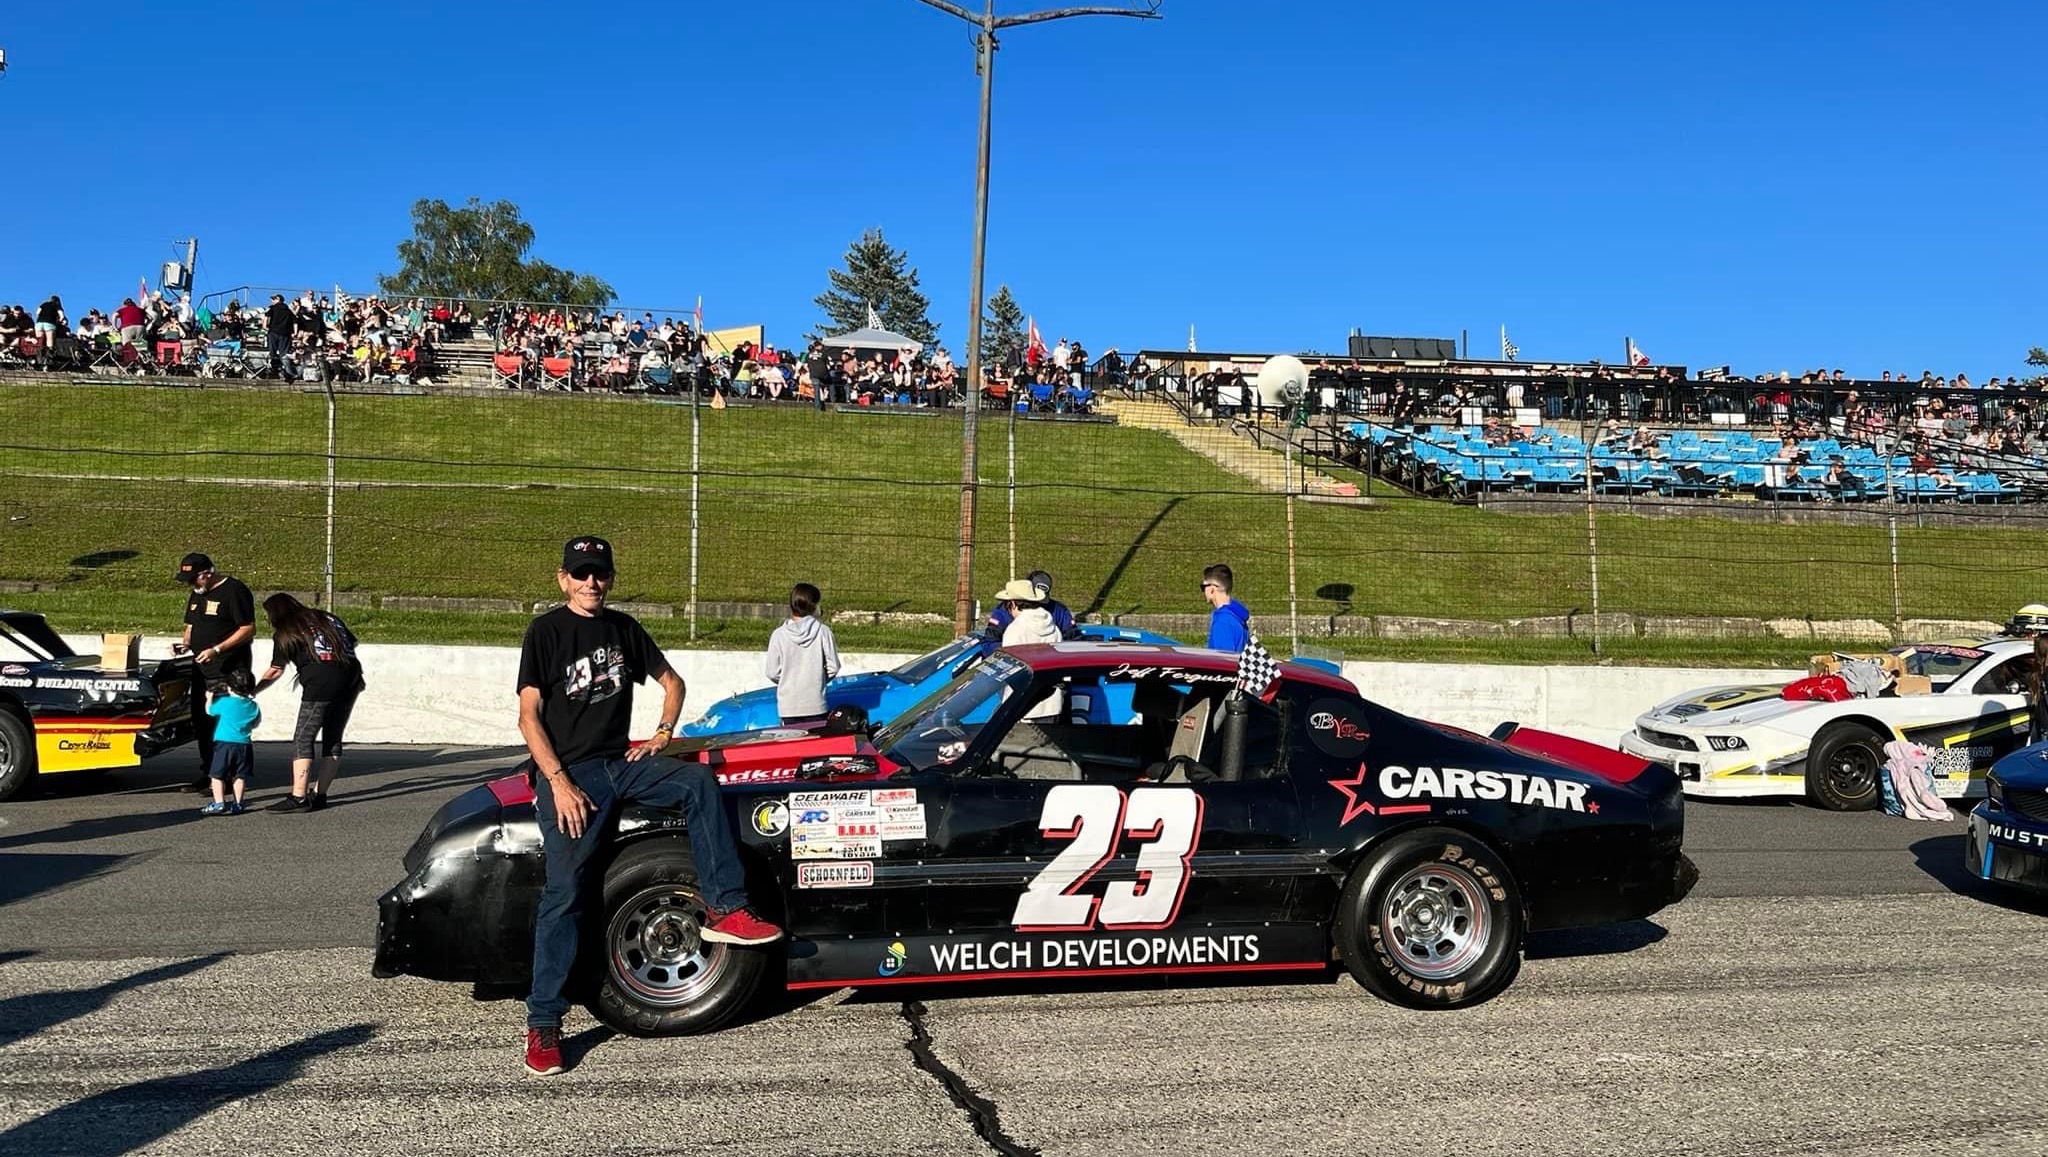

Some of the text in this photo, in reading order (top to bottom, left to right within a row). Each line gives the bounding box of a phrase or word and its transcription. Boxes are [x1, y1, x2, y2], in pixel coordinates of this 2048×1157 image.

[566, 656, 593, 696] 23
[1109, 662, 1157, 679] Jeff
[0, 676, 140, 691] ome BUILDING CENTRE
[794, 791, 868, 802] DELAWARE
[1379, 765, 1590, 813] CARSTAR
[799, 809, 830, 824] APC
[1989, 824, 2048, 848] MUST
[1011, 785, 1204, 931] 23
[803, 867, 869, 883] SCHOENFELD
[1440, 843, 1507, 902] RACER
[929, 934, 1260, 973] WELCH DEVELOPMENTS
